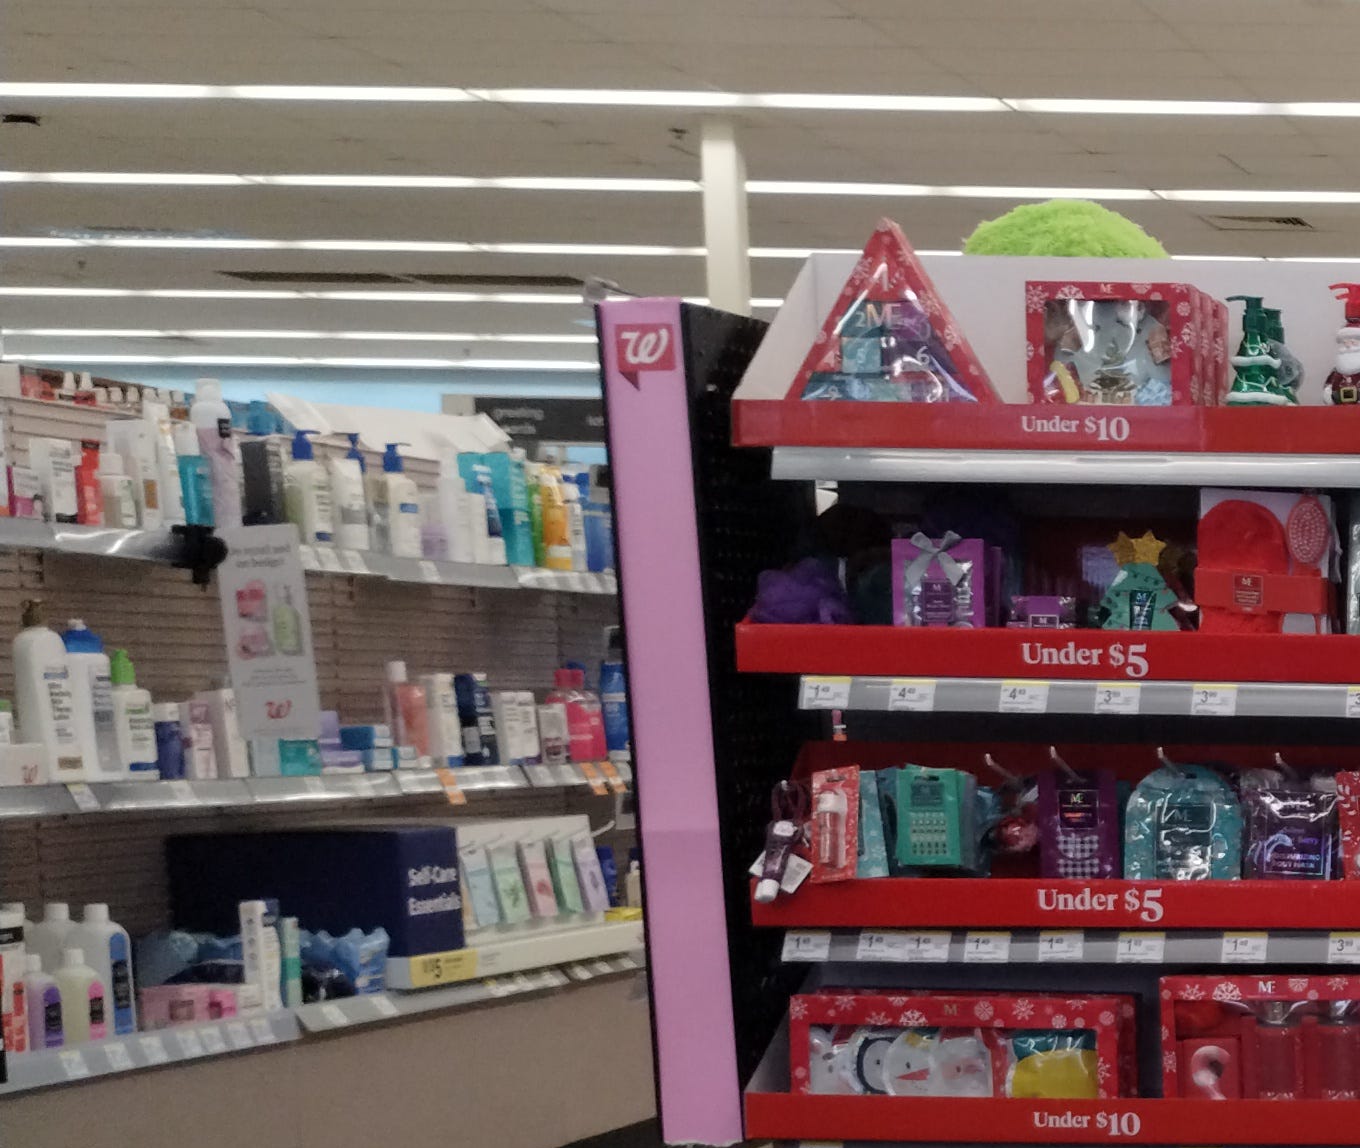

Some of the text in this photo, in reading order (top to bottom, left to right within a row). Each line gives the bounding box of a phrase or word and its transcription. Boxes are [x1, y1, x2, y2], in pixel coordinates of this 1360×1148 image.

[621, 328, 669, 364] W
[1021, 415, 1131, 442] Under $10
[1022, 642, 1149, 678] Under $5
[1038, 888, 1164, 923] Under $5
[1033, 1112, 1141, 1136] Under $10
